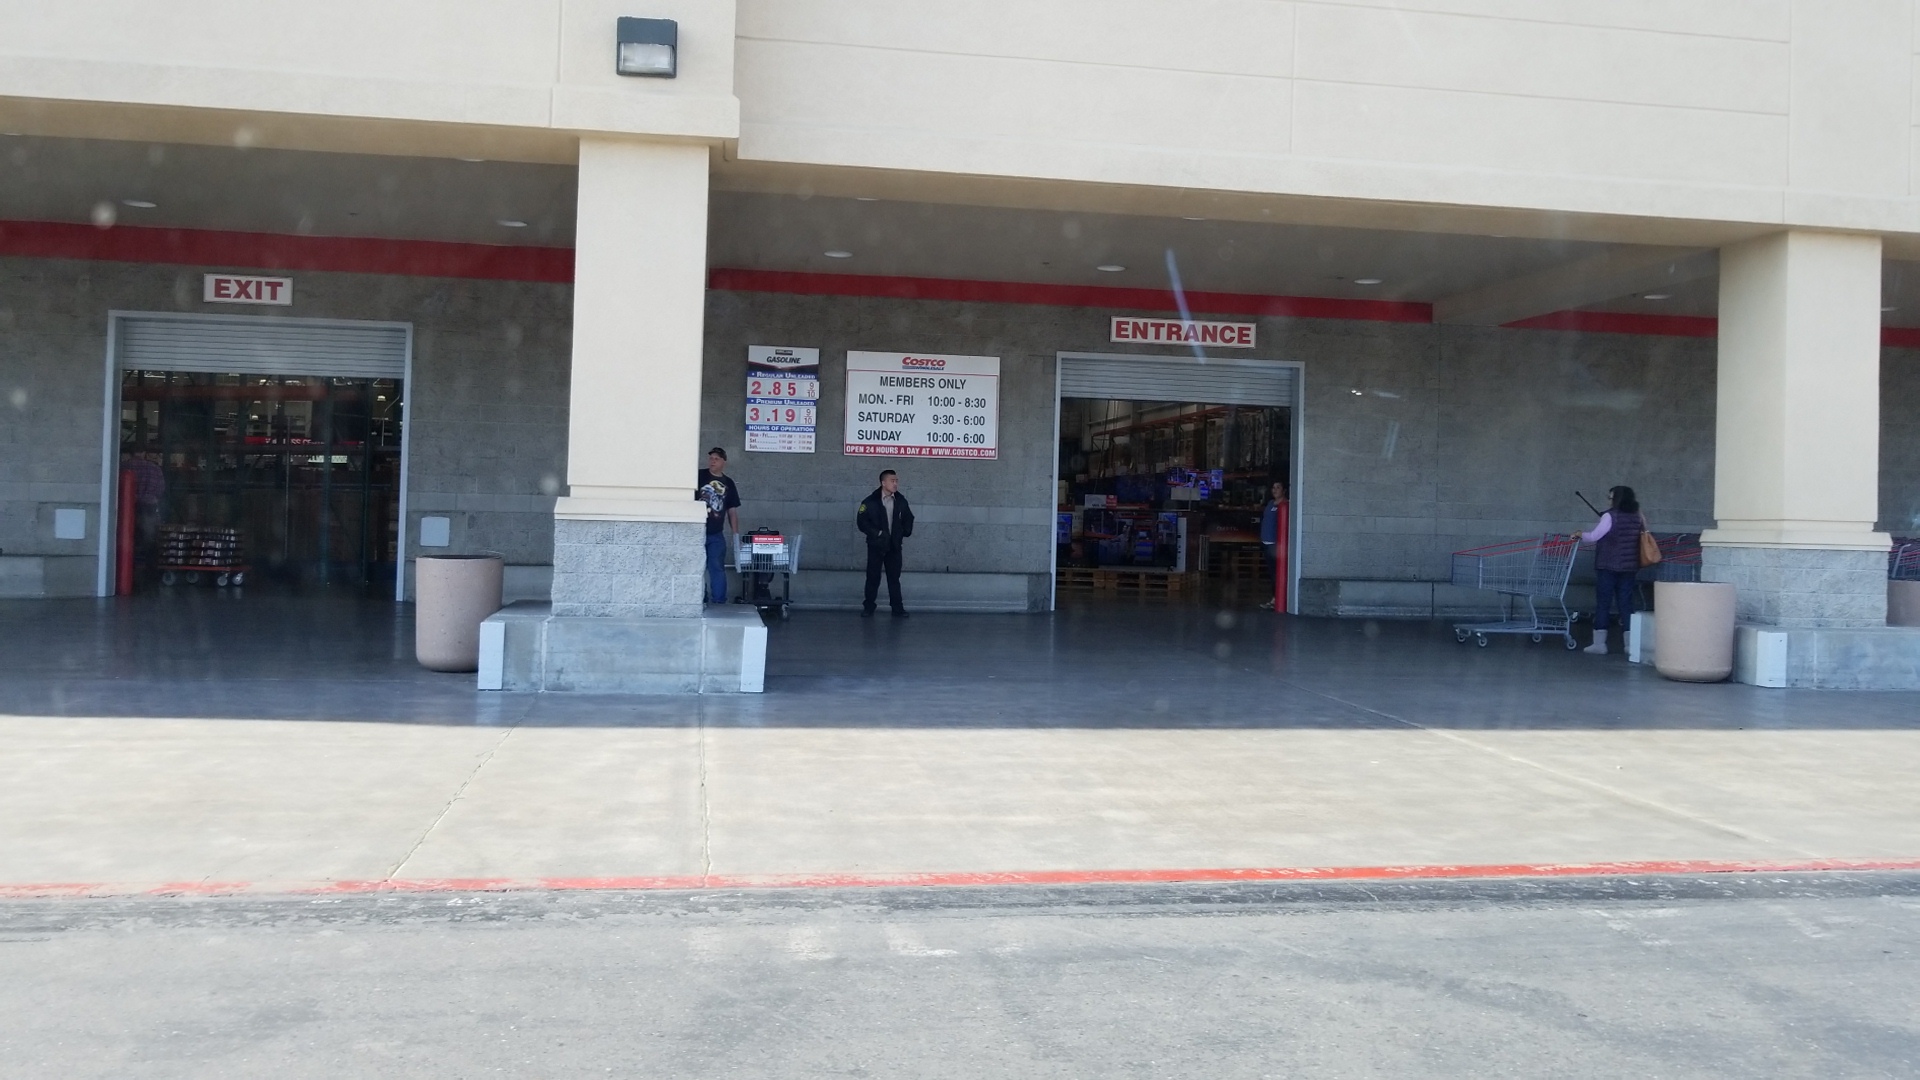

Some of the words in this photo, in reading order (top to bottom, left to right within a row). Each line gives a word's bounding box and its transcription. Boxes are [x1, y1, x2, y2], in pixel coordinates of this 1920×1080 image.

[214, 278, 284, 301] EXIT
[1115, 320, 1252, 345] ENTRANCE
[766, 356, 801, 364] GASOLINE
[785, 372, 816, 380] UNLEADED
[880, 376, 935, 388] MEMBERS
[938, 378, 967, 390] ONLY
[751, 381, 797, 397] 2.85
[809, 382, 815, 390] 9
[784, 399, 815, 407] UNLEADED
[858, 393, 887, 405] MON.
[896, 395, 914, 405] FRI
[928, 396, 956, 408] 10:00
[964, 398, 986, 409] 8:30
[749, 407, 796, 423] 3.19
[806, 409, 812, 417] 9
[858, 411, 915, 424] SATURDAY
[932, 414, 954, 425] 9:30
[963, 416, 985, 426] 6:00
[804, 417, 813, 425] 10
[857, 429, 902, 441] SUNDAY
[927, 432, 954, 443] 10:00
[963, 433, 985, 444] 6:00
[846, 445, 864, 453] OPEN
[931, 449, 996, 457] WWW.COSTCO.COM
